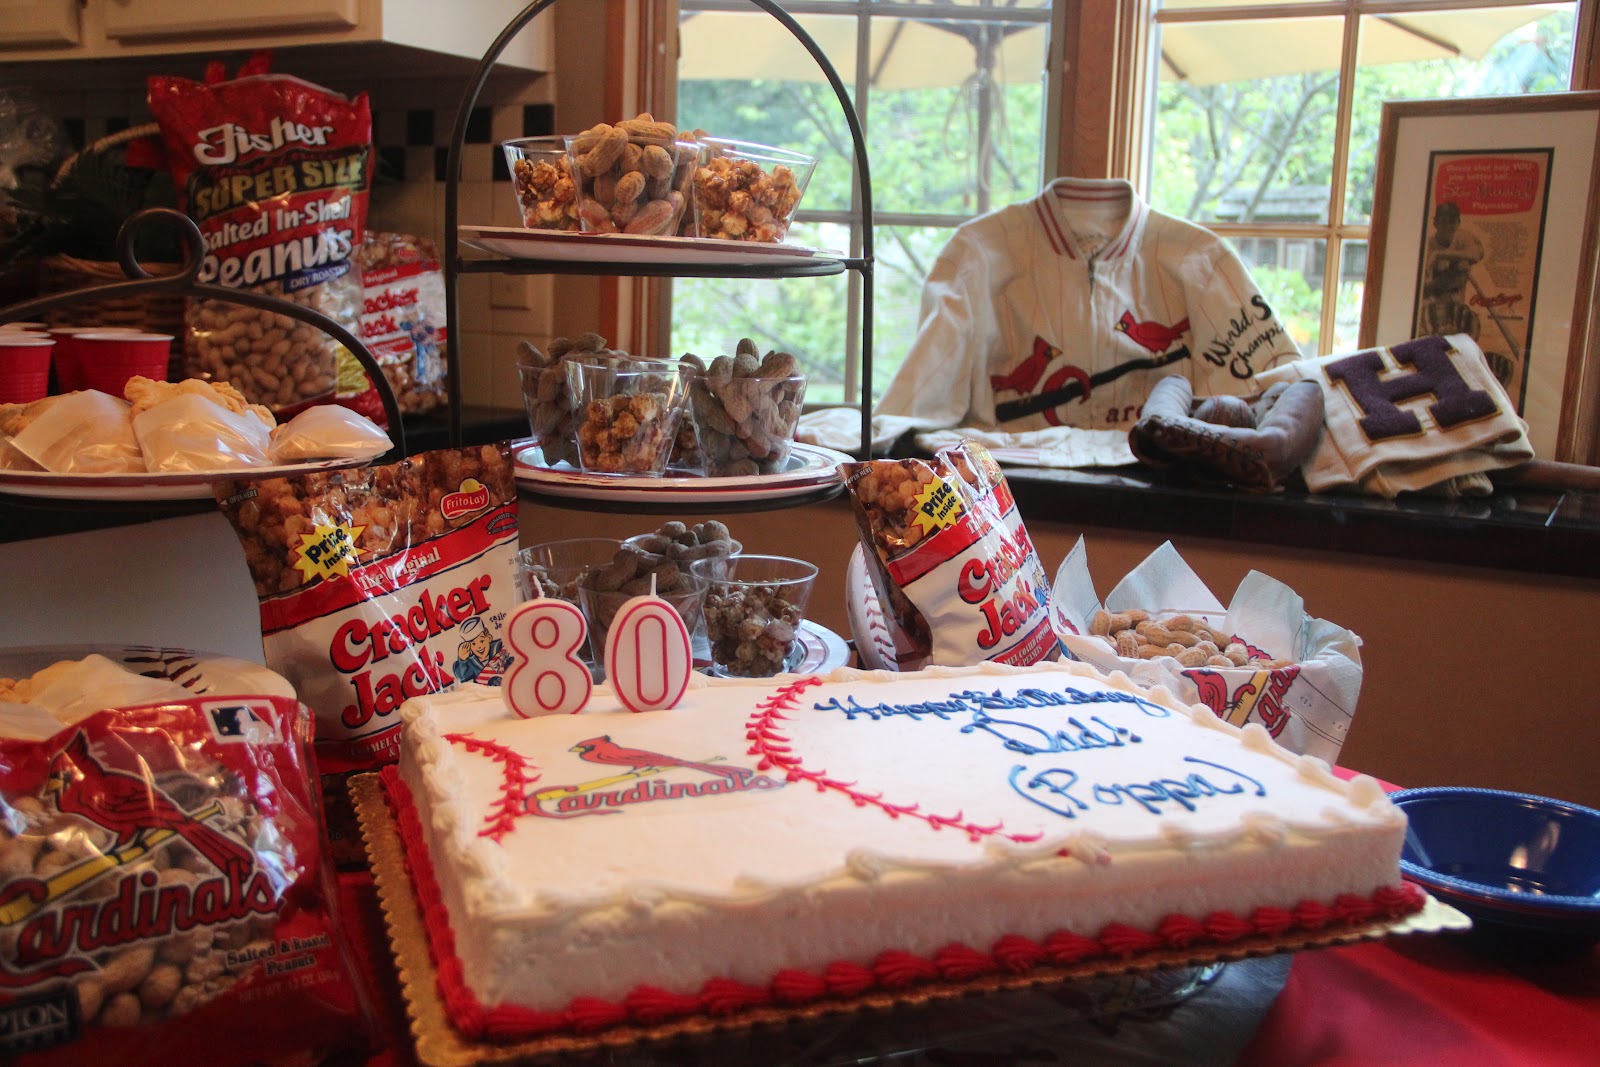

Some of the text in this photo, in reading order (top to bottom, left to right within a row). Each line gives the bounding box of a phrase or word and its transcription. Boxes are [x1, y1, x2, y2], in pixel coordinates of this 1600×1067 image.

[194, 116, 334, 165] Fisher
[195, 153, 363, 218] SUPER SIZE
[202, 195, 351, 251] Salted In-Shell
[198, 226, 353, 288] Peanuts
[1203, 308, 1252, 367] World
[1323, 334, 1503, 445] H
[358, 573, 384, 591] The
[330, 574, 492, 673] Cracker
[977, 575, 1039, 650] Jack
[341, 645, 455, 729] Jack
[814, 695, 969, 720] Happy
[960, 714, 1143, 755] Dad!
[524, 771, 786, 819] Cardinals
[1008, 756, 1266, 818] (Poppa)
[227, 941, 276, 966] Salted
[279, 937, 291, 953] &
[266, 956, 316, 975] Peanuts
